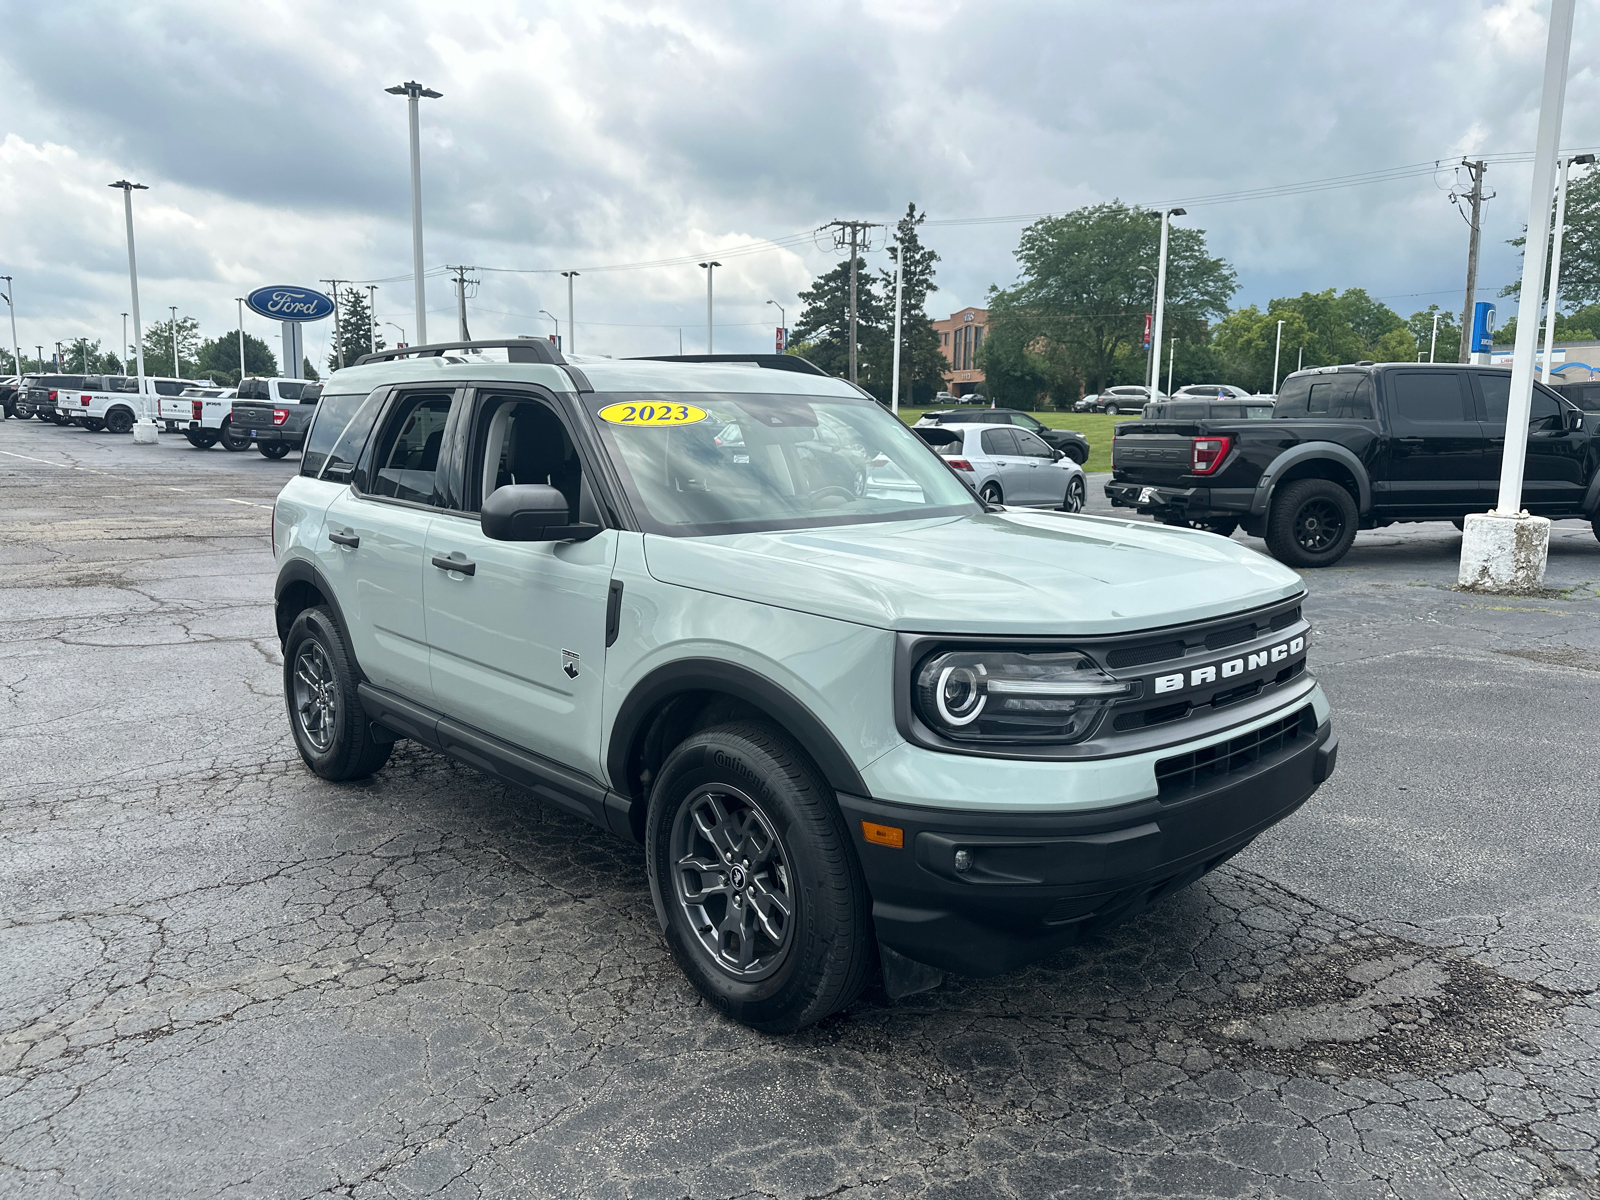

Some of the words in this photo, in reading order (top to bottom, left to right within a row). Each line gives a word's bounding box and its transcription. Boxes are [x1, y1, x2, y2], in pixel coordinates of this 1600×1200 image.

[268, 291, 318, 314] Ford
[620, 405, 689, 422] 2023
[1121, 448, 1181, 459] FORD
[1154, 636, 1304, 694] BRONCO
[714, 749, 777, 803] Continental
